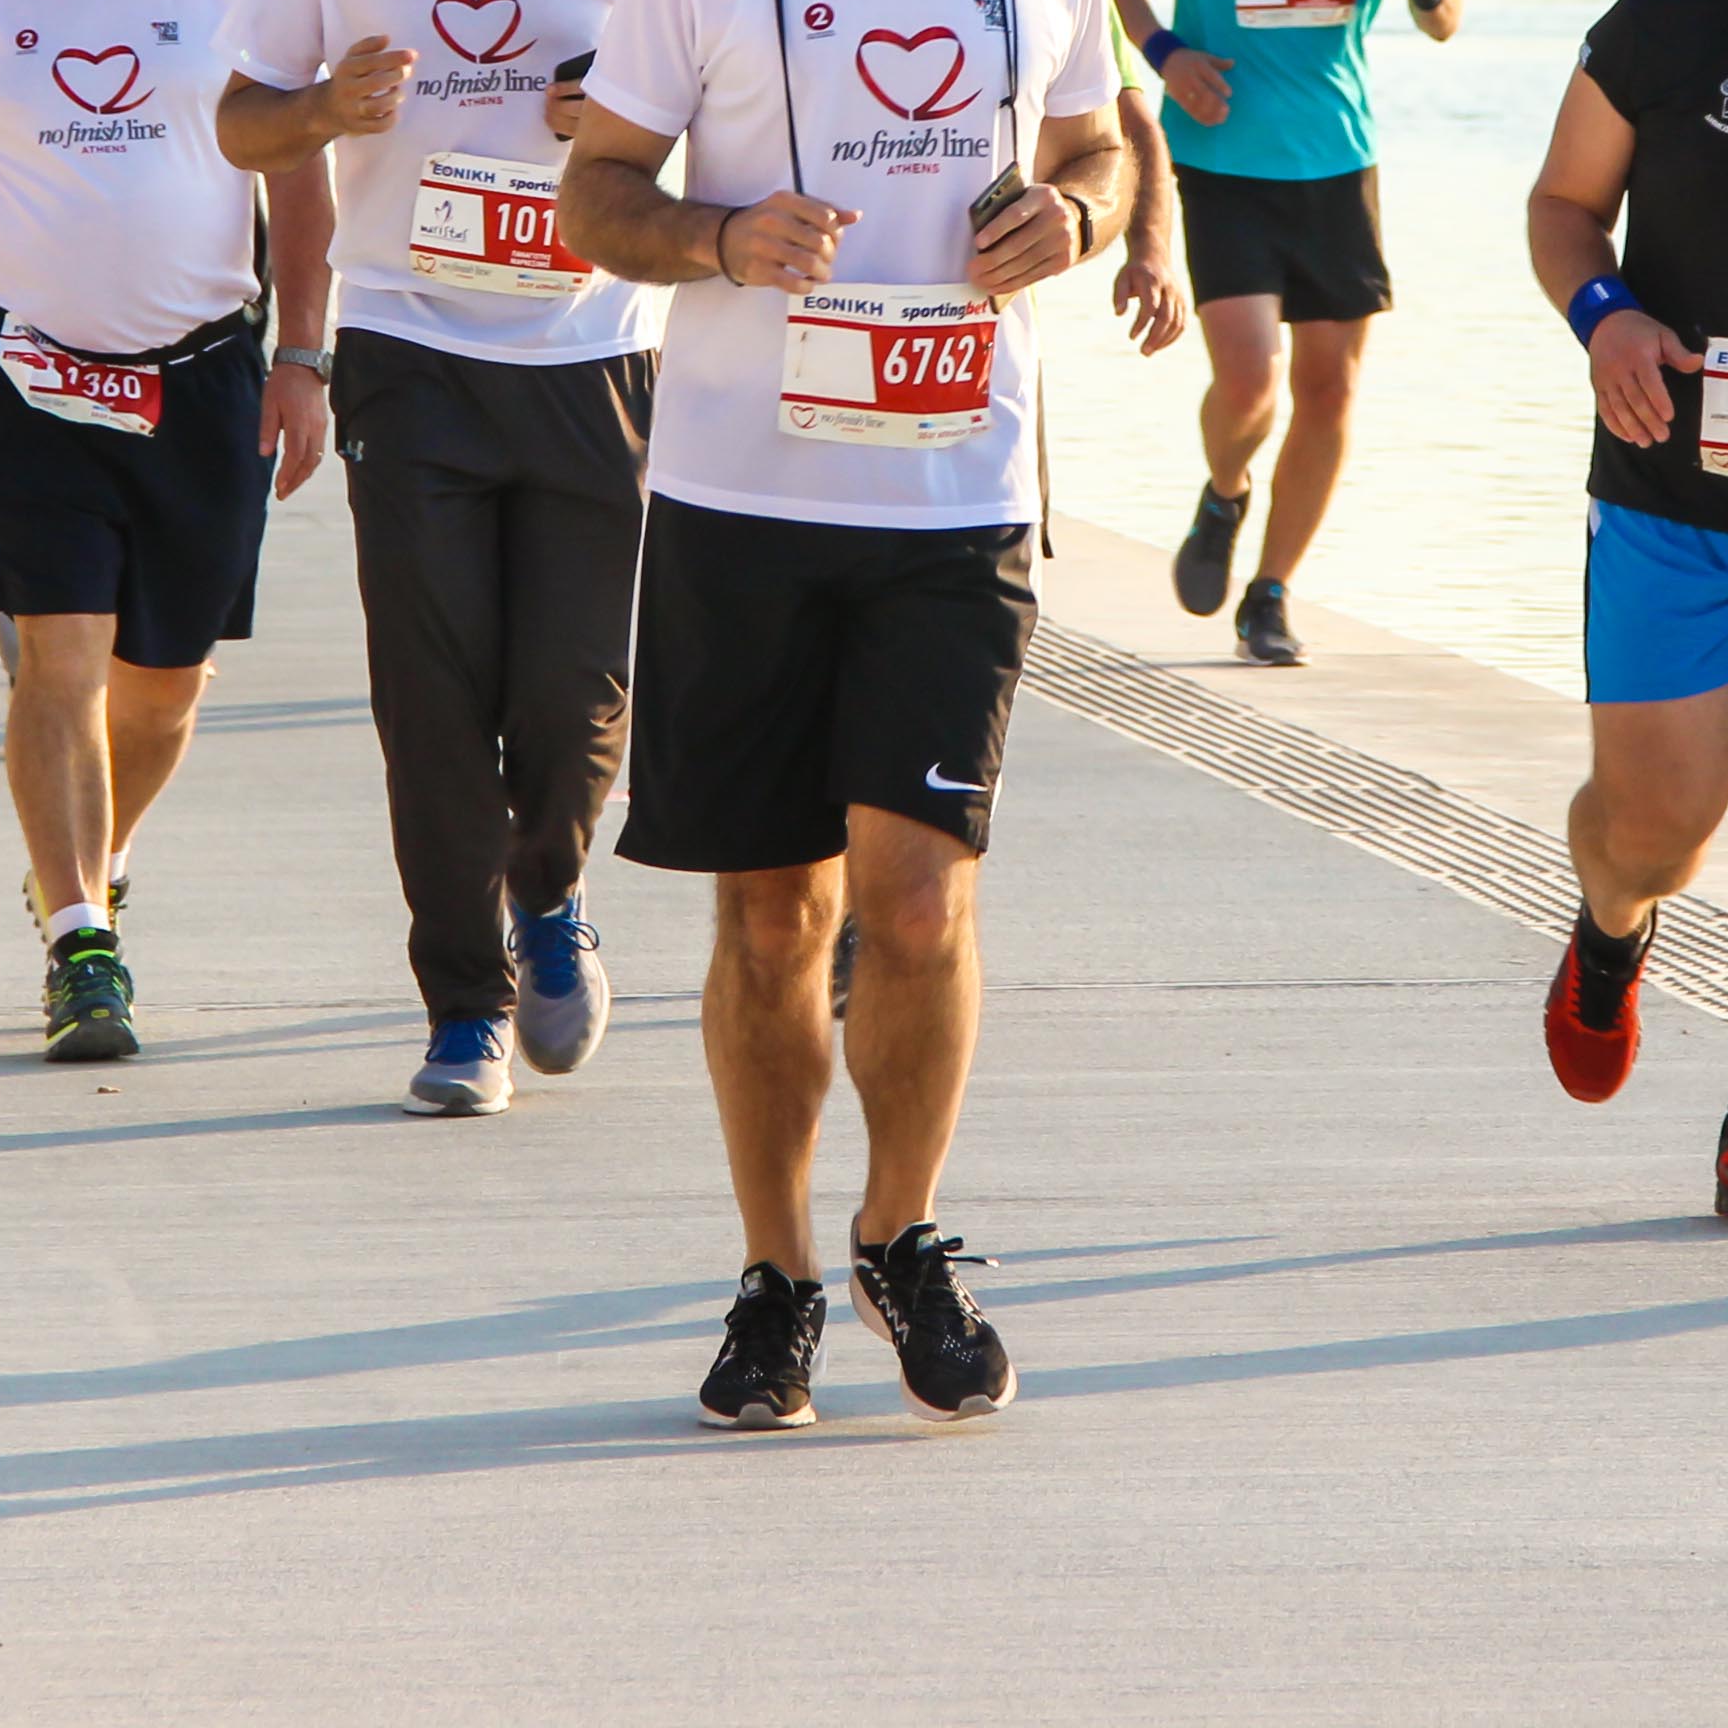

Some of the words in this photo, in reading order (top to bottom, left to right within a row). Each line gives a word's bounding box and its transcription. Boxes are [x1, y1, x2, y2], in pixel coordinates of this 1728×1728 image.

[810, 7, 828, 27] 2
[21, 32, 33, 46] 2
[416, 79, 441, 95] no
[440, 68, 501, 101] finish
[504, 68, 546, 92] line
[458, 96, 504, 108] ATHENS
[38, 129, 63, 145] no
[62, 119, 124, 149] finish
[127, 119, 166, 140] line
[81, 145, 127, 154] ATHENS
[832, 140, 866, 161] no
[863, 128, 938, 167] finish
[942, 128, 990, 157] line
[887, 163, 940, 176] ATHENS
[497, 202, 566, 248] 101
[901, 300, 988, 321] sportingbet
[883, 334, 975, 385] 6762
[66, 366, 142, 399] 1360
